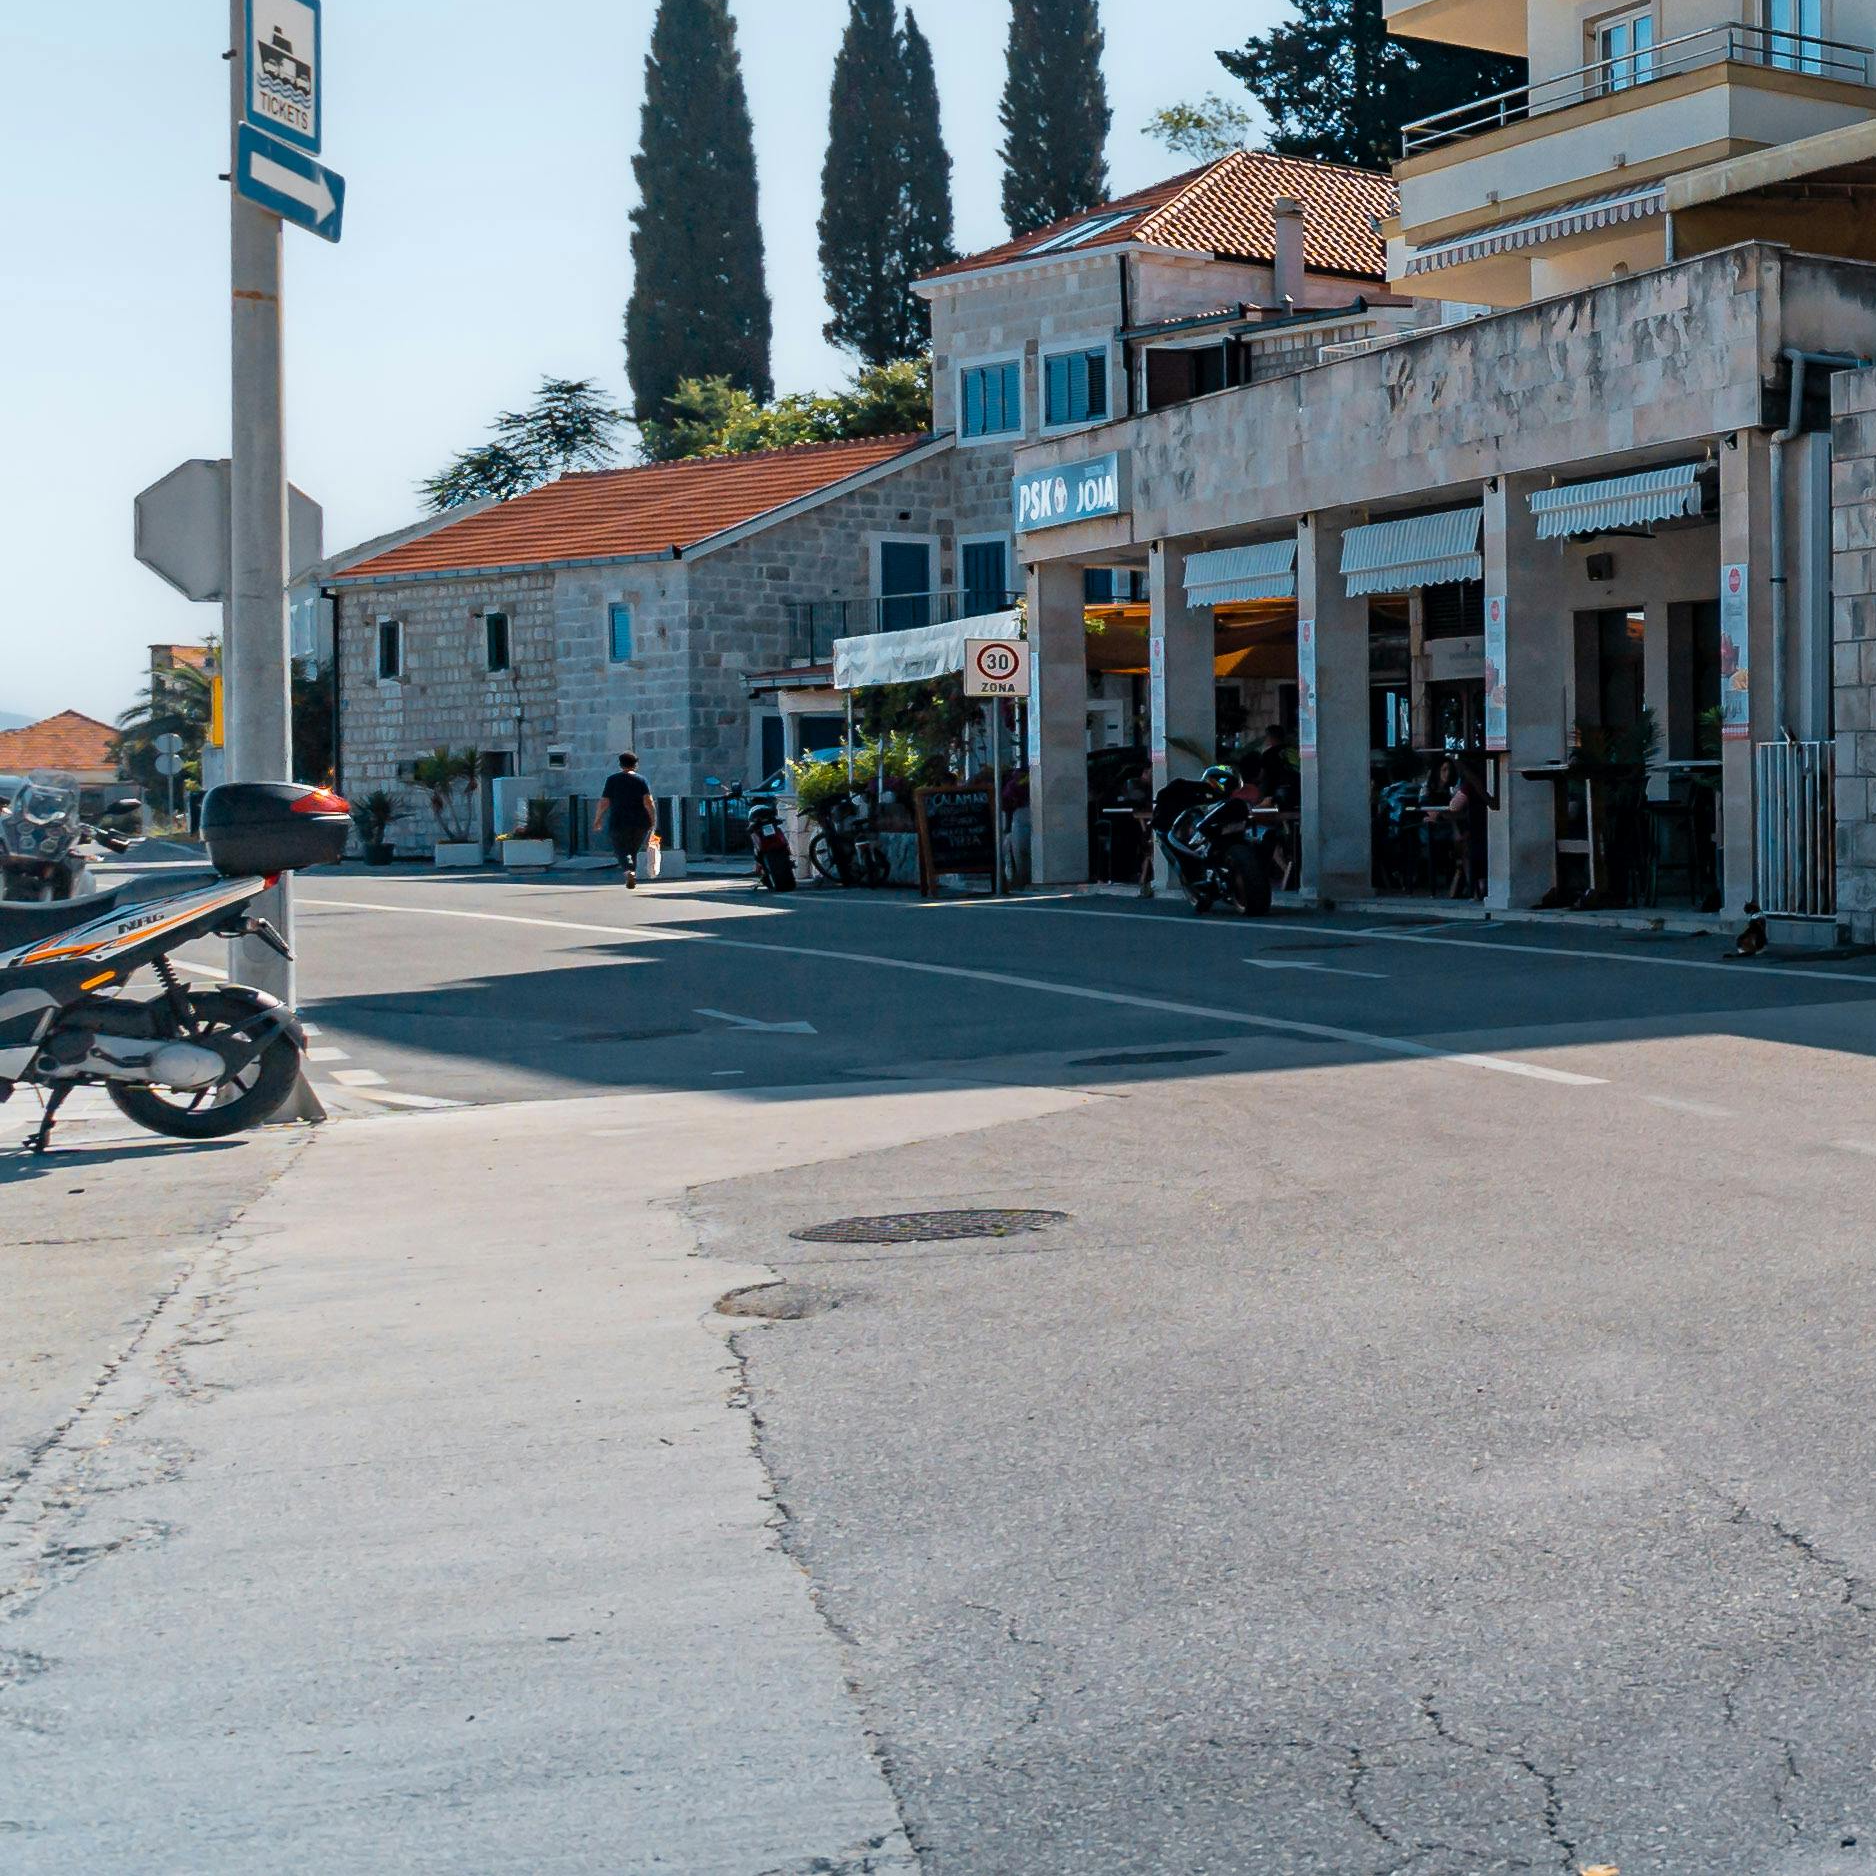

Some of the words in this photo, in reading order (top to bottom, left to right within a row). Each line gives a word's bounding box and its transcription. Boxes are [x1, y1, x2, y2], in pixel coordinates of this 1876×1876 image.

[260, 91, 308, 130] TICKETS
[1019, 478, 1052, 523] PSK
[986, 653, 1009, 670] 30
[981, 682, 1016, 693] ZONA
